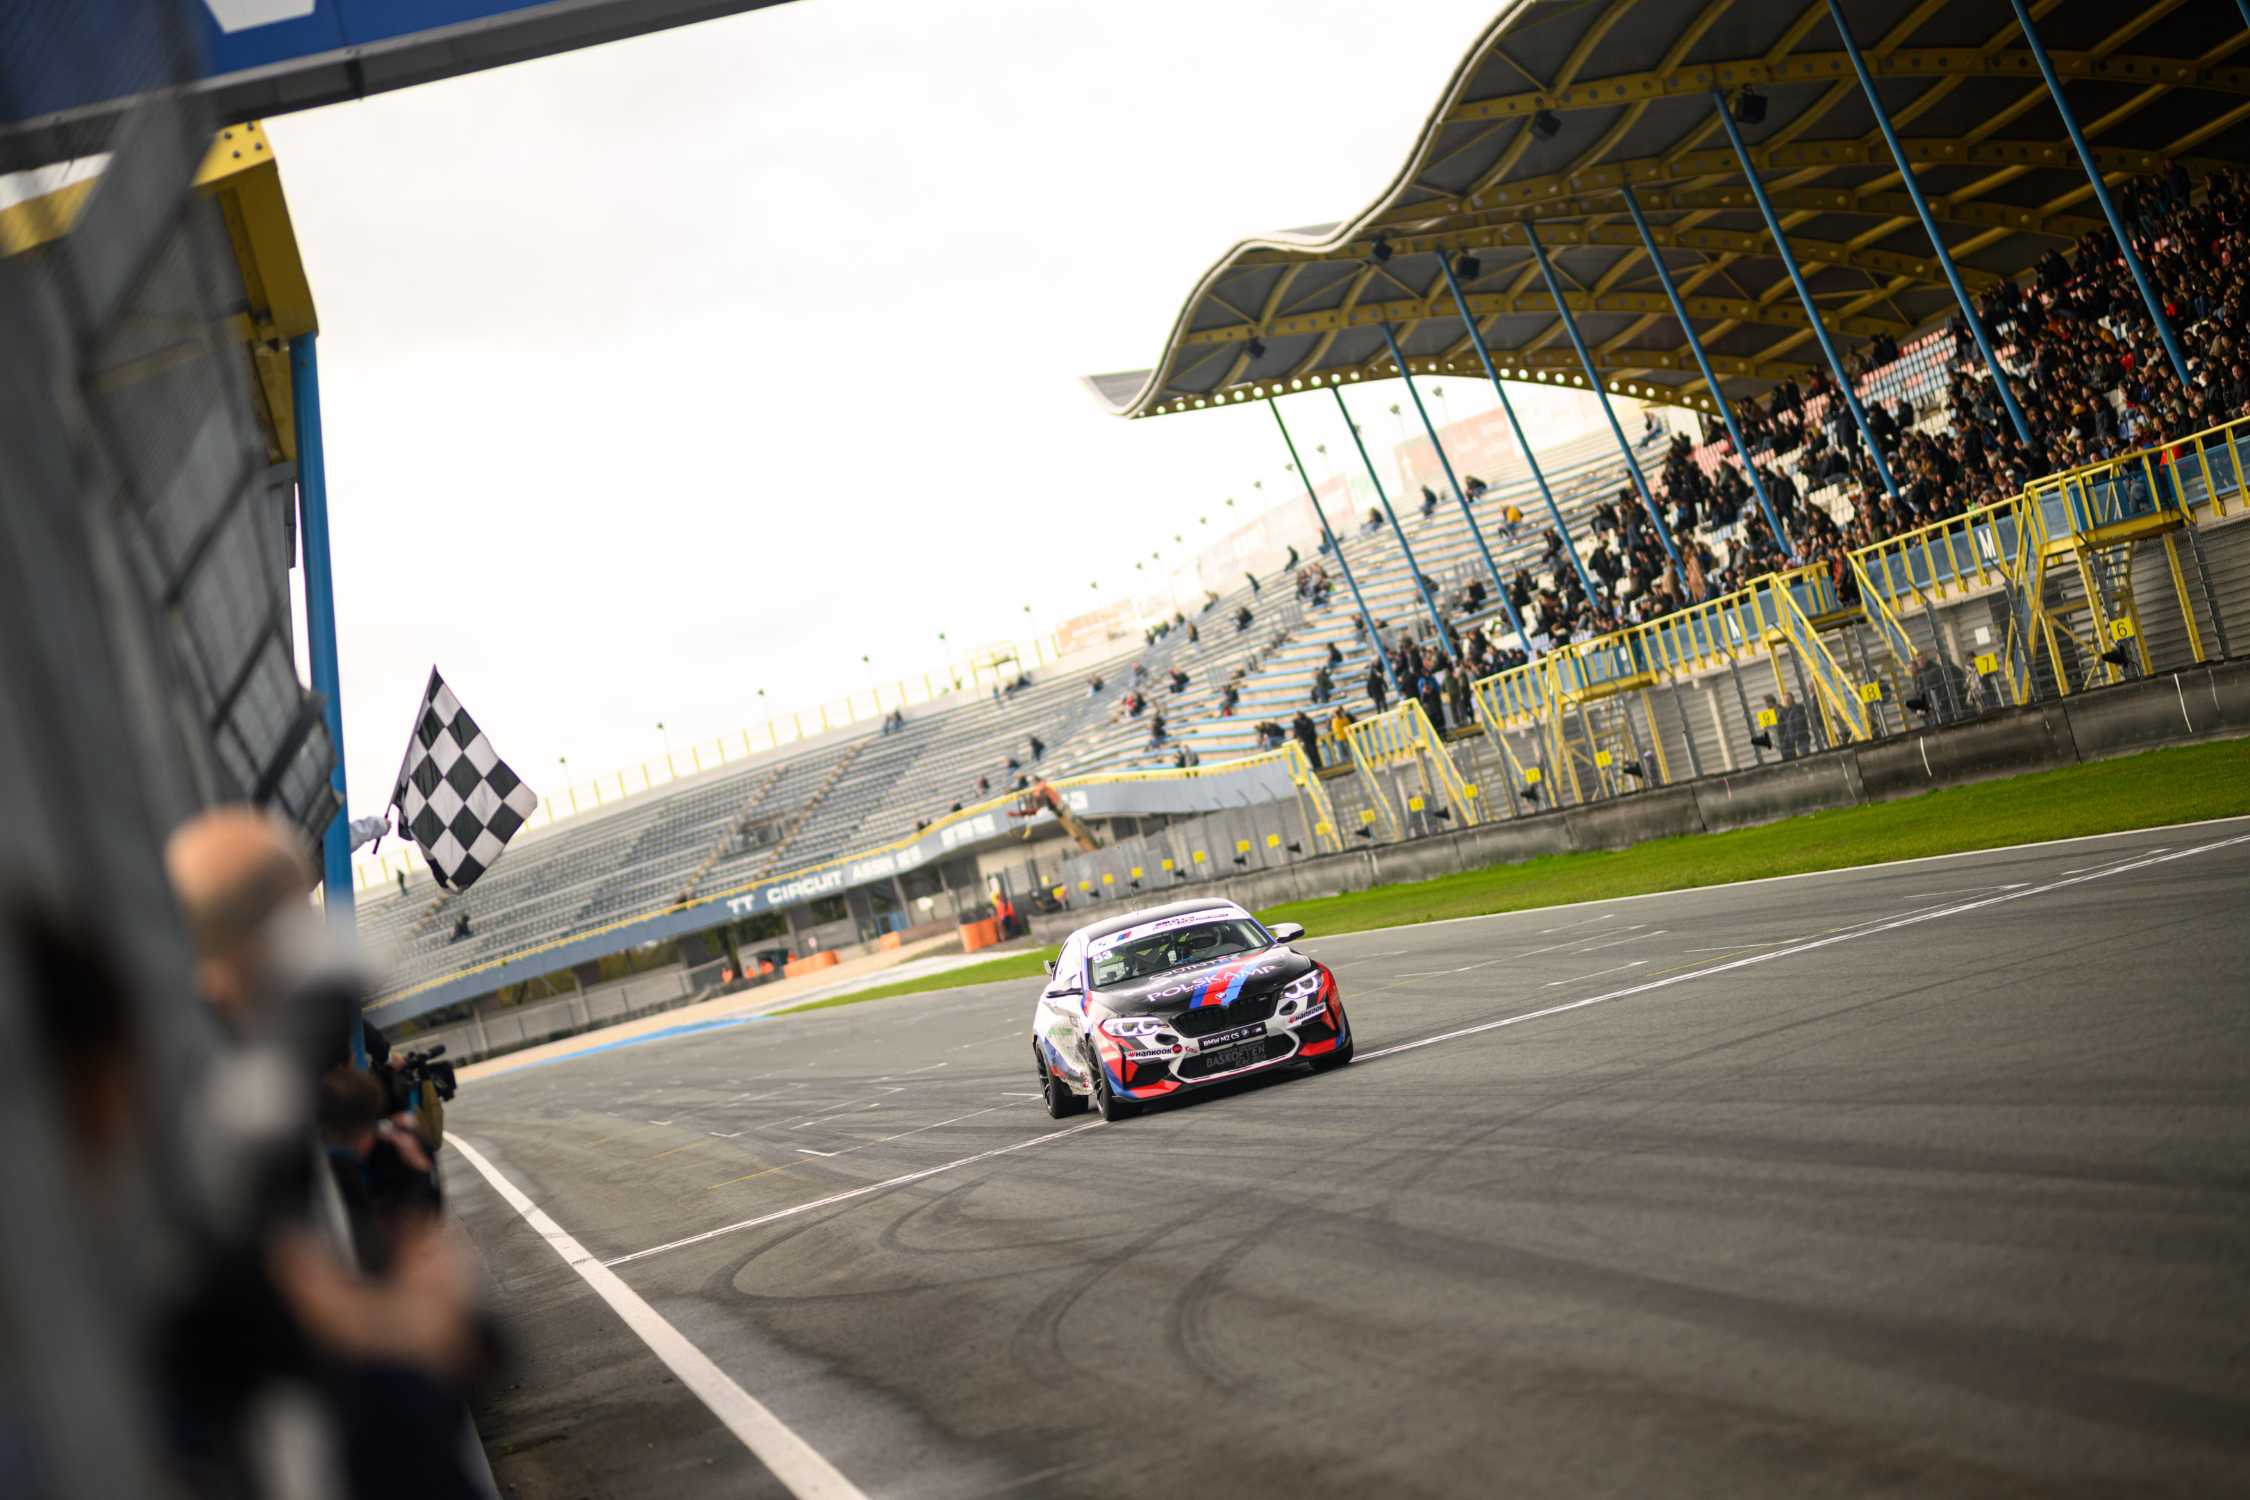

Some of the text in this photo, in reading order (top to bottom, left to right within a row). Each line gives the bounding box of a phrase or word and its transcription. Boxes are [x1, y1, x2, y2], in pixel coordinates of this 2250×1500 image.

[1978, 528, 1997, 559] M
[1727, 614, 1741, 640] A
[2116, 621, 2128, 637] 6
[1982, 655, 1991, 672] 7
[1865, 685, 1877, 700] 8
[1762, 711, 1771, 725] 9
[727, 894, 755, 915] TT
[767, 871, 843, 904] CIRCUIT
[1146, 965, 1276, 1001] POLSKAMP
[1203, 1037, 1220, 1047] BMW
